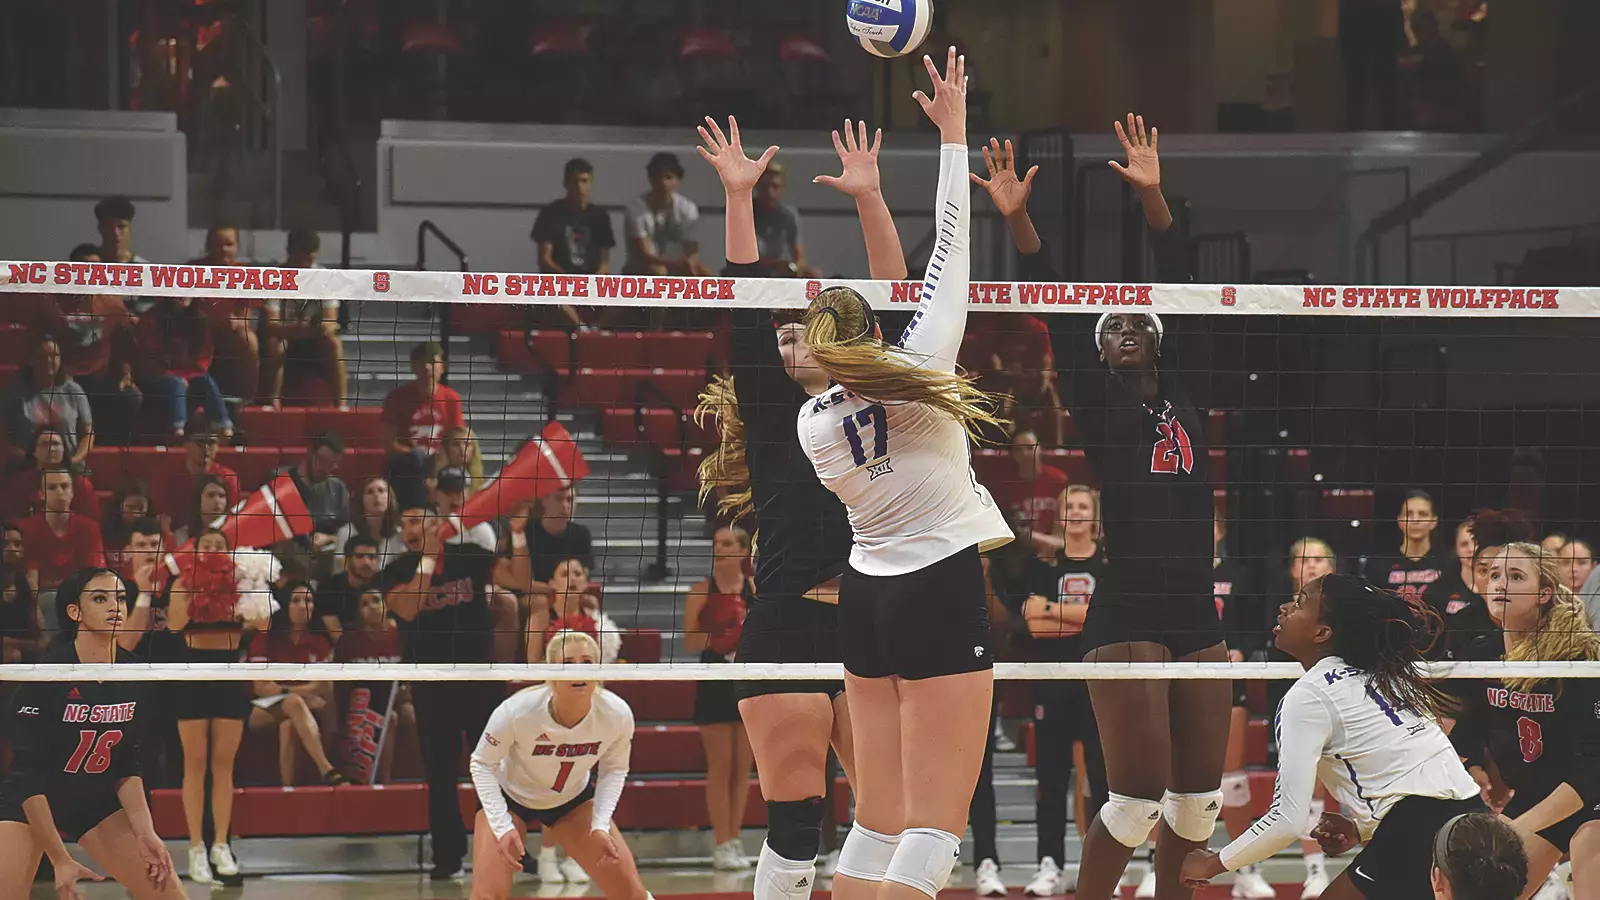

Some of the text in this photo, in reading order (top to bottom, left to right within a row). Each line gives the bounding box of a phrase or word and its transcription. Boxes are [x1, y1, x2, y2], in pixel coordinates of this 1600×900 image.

[850, 2, 880, 20] NCAA
[9, 264, 299, 290] NC STATE WOLFPACK
[463, 274, 735, 299] NC STATE WOLFPACK
[890, 282, 1152, 305] NC ATE WOLFPACK
[1303, 287, 1559, 309] NC STATE WOLFPACK
[843, 404, 888, 468] 17
[1151, 415, 1194, 475] 21
[17, 706, 39, 715] ACC
[1487, 687, 1555, 712] NC STATE
[63, 702, 136, 723] NC STATE
[555, 741, 602, 757] STATE
[1517, 716, 1543, 763] 8
[551, 762, 575, 793] 1
